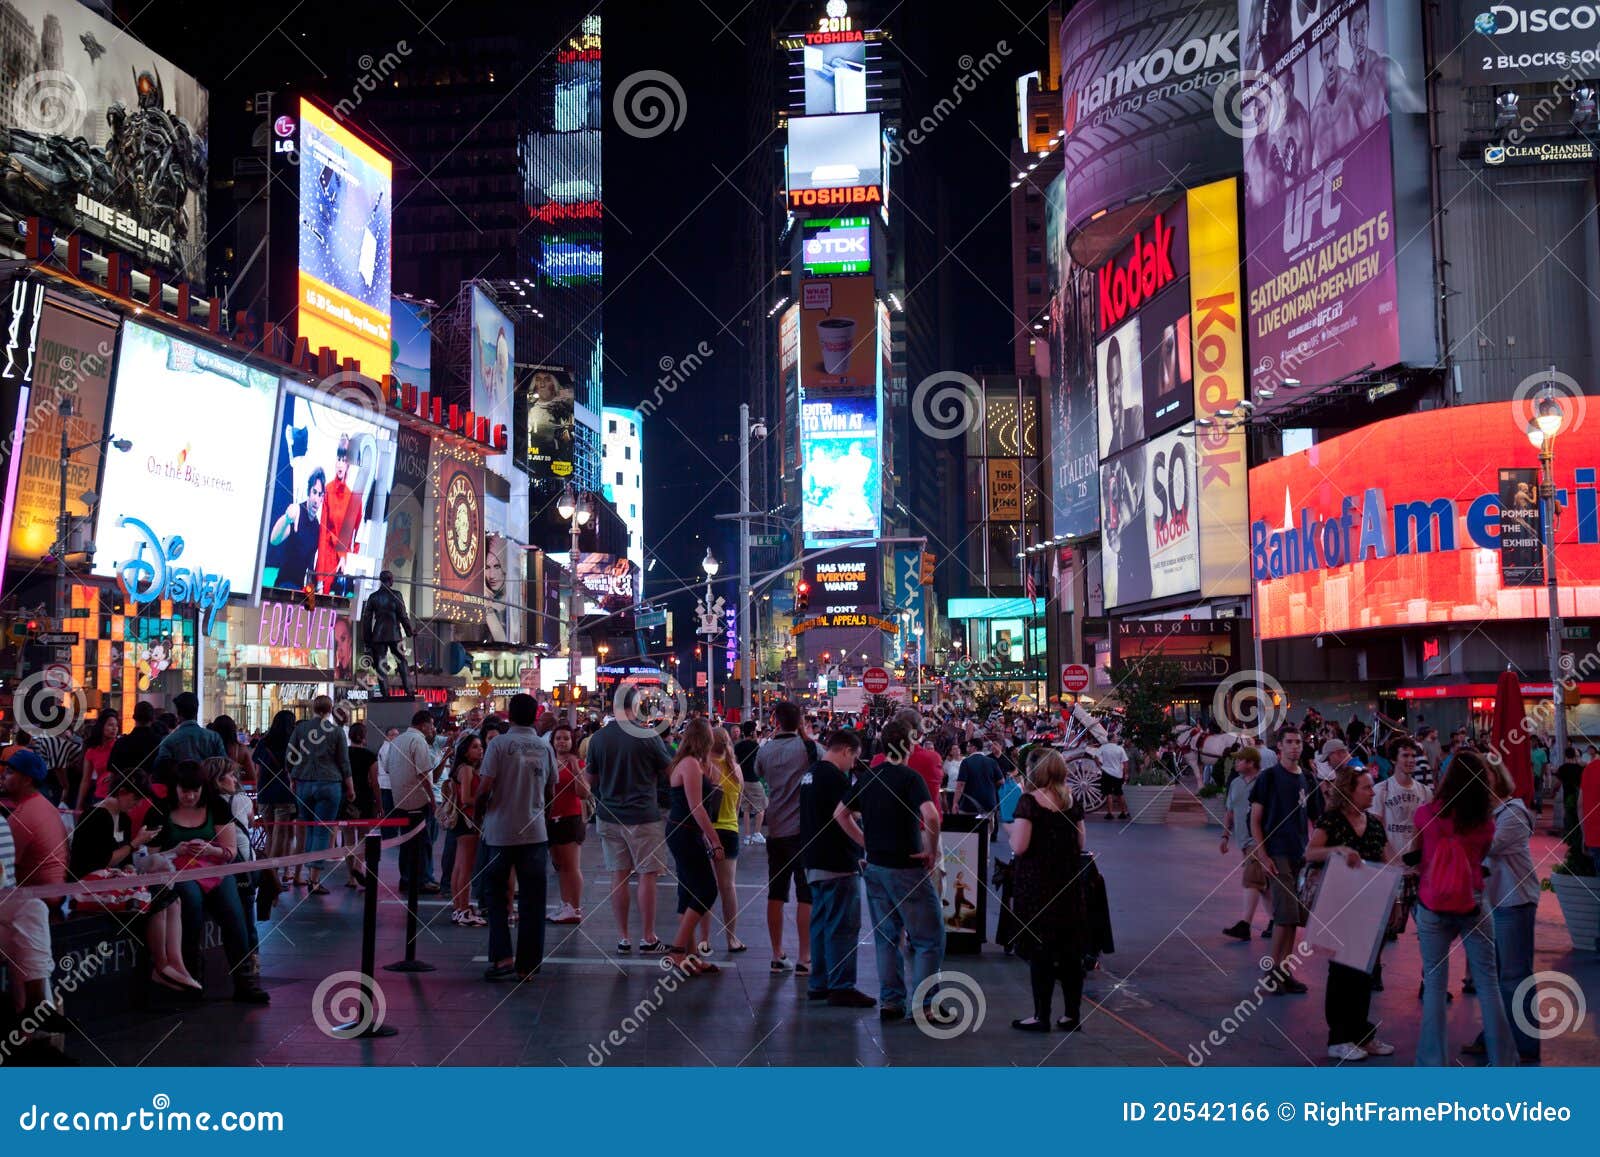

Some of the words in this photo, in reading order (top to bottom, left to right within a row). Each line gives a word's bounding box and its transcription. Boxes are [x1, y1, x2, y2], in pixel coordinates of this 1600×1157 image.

[819, 17, 851, 32] 2011
[1490, 5, 1600, 35] DISCO
[806, 31, 863, 44] TOSHIBA
[1482, 57, 1493, 70] 2
[1497, 51, 1566, 68] BLOCKS
[1092, 93, 1143, 128] driving
[1146, 68, 1239, 103] emotion
[275, 140, 294, 153] LG
[790, 187, 880, 206] TOSHIBA
[1283, 158, 1344, 253] UFC
[822, 237, 866, 253] TDK
[1251, 255, 1316, 316] SATURDAY,
[1318, 217, 1377, 276] AUGUST
[1378, 211, 1390, 241] 6
[1100, 213, 1175, 333] Kodak
[1258, 308, 1282, 338] LIVE
[1281, 300, 1297, 325] ON
[1195, 292, 1238, 490] Kodak
[803, 403, 832, 416] ENTER
[803, 415, 819, 431] TO
[821, 414, 846, 430] WIN
[849, 413, 863, 429] AT
[24, 455, 90, 488] ANYWERE?
[996, 470, 1013, 479] THE
[993, 482, 1017, 496] LION
[1153, 442, 1188, 530] SO
[1502, 524, 1521, 533] THE
[1252, 507, 1318, 581] Bank
[1324, 496, 1361, 568] of
[1503, 538, 1538, 547] EXHIBIT
[817, 563, 836, 573] HAS
[838, 562, 866, 572] WHAT
[816, 572, 866, 582] EVERYONE
[824, 581, 858, 591] WANTS
[258, 601, 337, 649] FOREVER
[832, 615, 867, 626] APPEALS
[1119, 620, 1232, 634] MARQUIS
